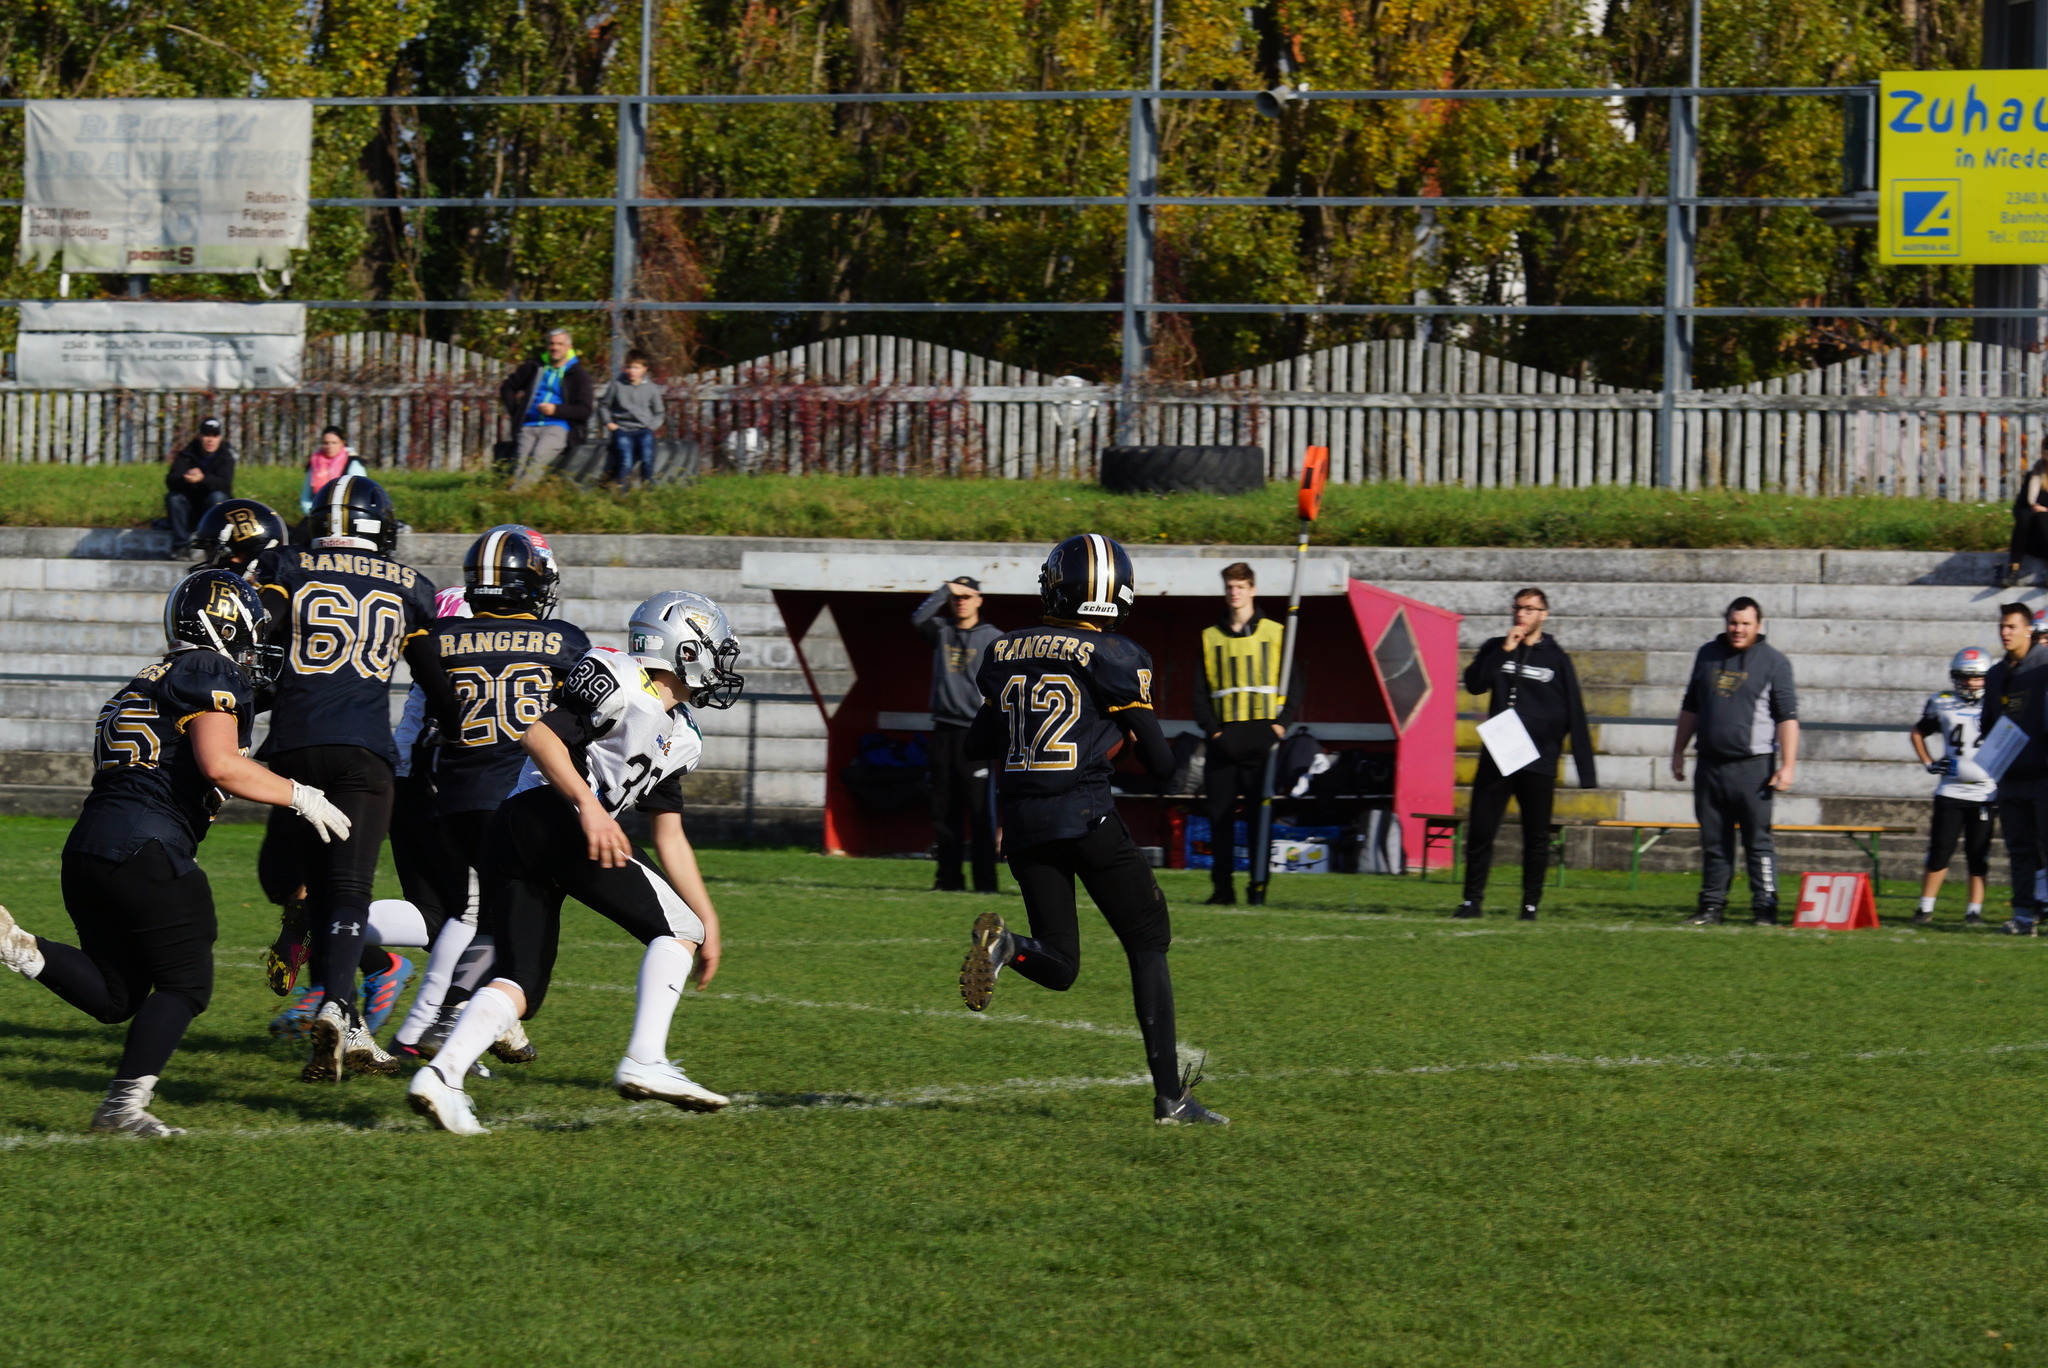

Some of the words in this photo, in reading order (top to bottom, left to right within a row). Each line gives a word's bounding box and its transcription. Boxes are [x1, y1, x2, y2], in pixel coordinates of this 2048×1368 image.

[1955, 147, 1976, 169] in
[300, 551, 416, 590] RANGERS
[1082, 603, 1116, 614] schutt
[289, 581, 407, 683] 60
[439, 631, 564, 658] RANGERS
[993, 635, 1095, 668] RANGERS
[566, 659, 616, 704] 39
[447, 661, 553, 748] 26
[1001, 673, 1081, 772] 12
[1800, 874, 1858, 924] 50
